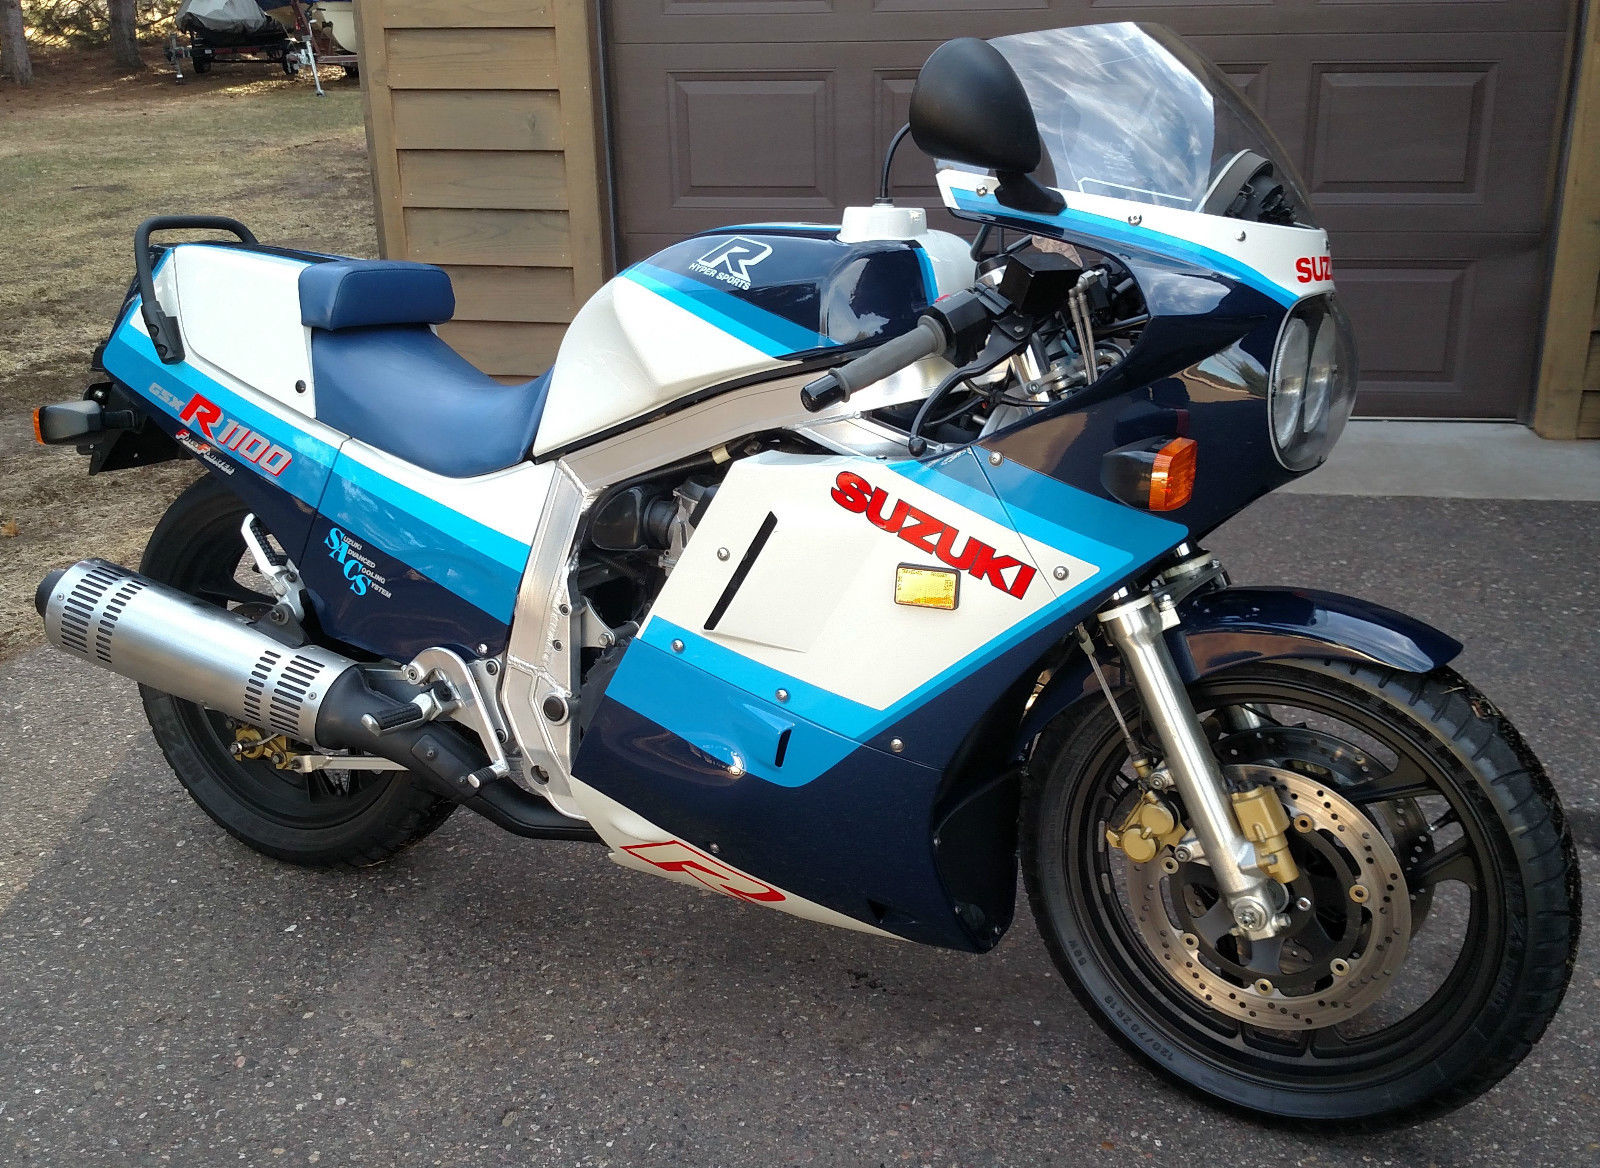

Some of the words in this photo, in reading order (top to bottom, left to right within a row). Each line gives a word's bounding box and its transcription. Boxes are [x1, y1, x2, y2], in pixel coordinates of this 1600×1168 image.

[688, 262, 718, 277] HYPER
[716, 271, 751, 291] SPORTS
[697, 235, 773, 282] R
[1296, 256, 1333, 283] SUZ
[830, 471, 1037, 600] SUZUKI
